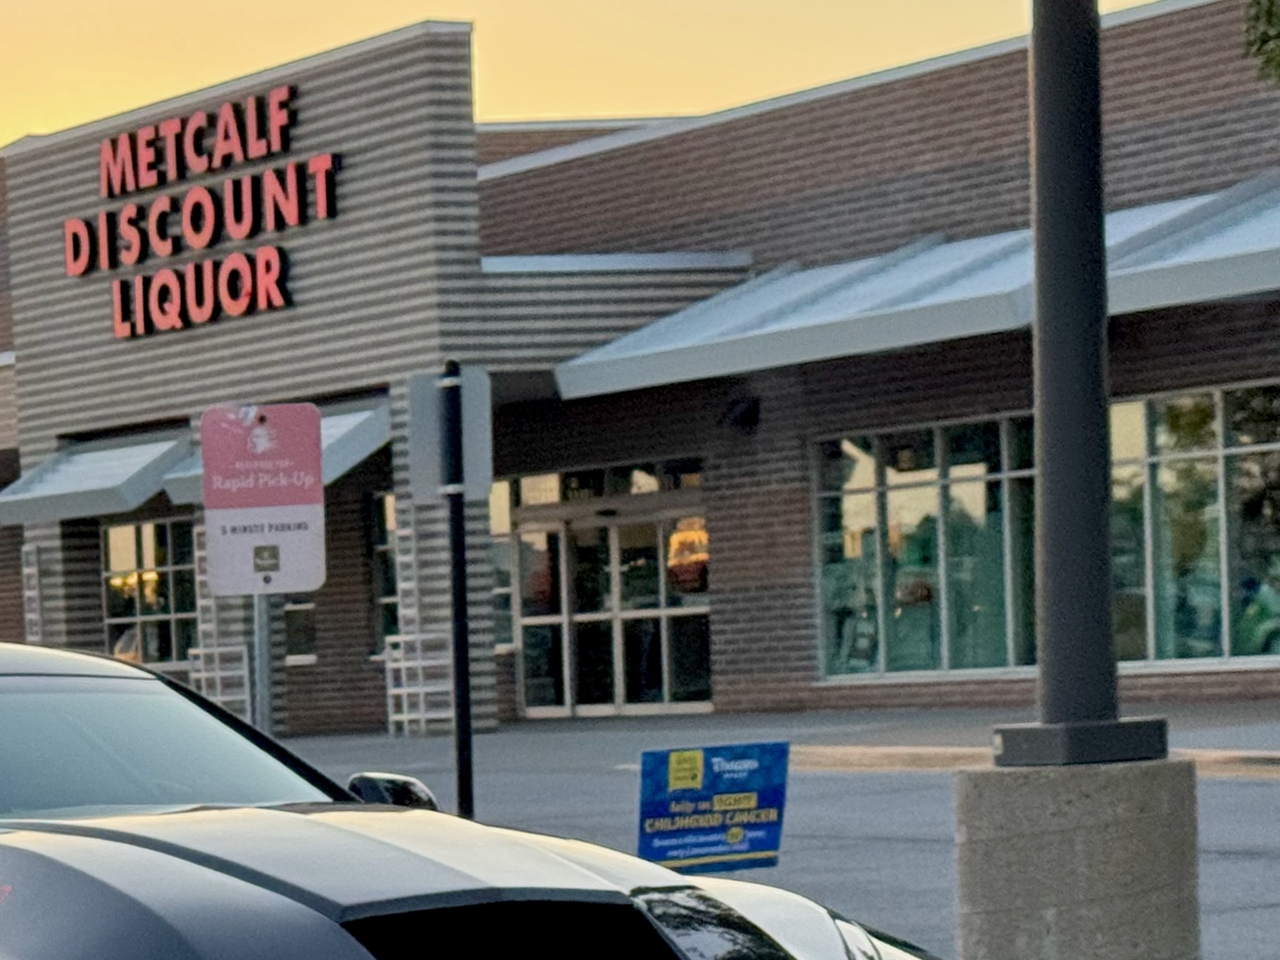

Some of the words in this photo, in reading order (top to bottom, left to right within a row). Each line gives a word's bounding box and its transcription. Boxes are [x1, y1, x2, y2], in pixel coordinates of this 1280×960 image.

[100, 85, 290, 198] METCALF
[64, 154, 333, 276] DISCOUNT
[112, 245, 285, 338] LIQUOR
[213, 473, 255, 491] Rapid
[257, 471, 314, 490] Pick-Up
[230, 524, 265, 535] MINUTE
[268, 522, 309, 533] PARKING
[726, 809, 778, 824] CANCER
